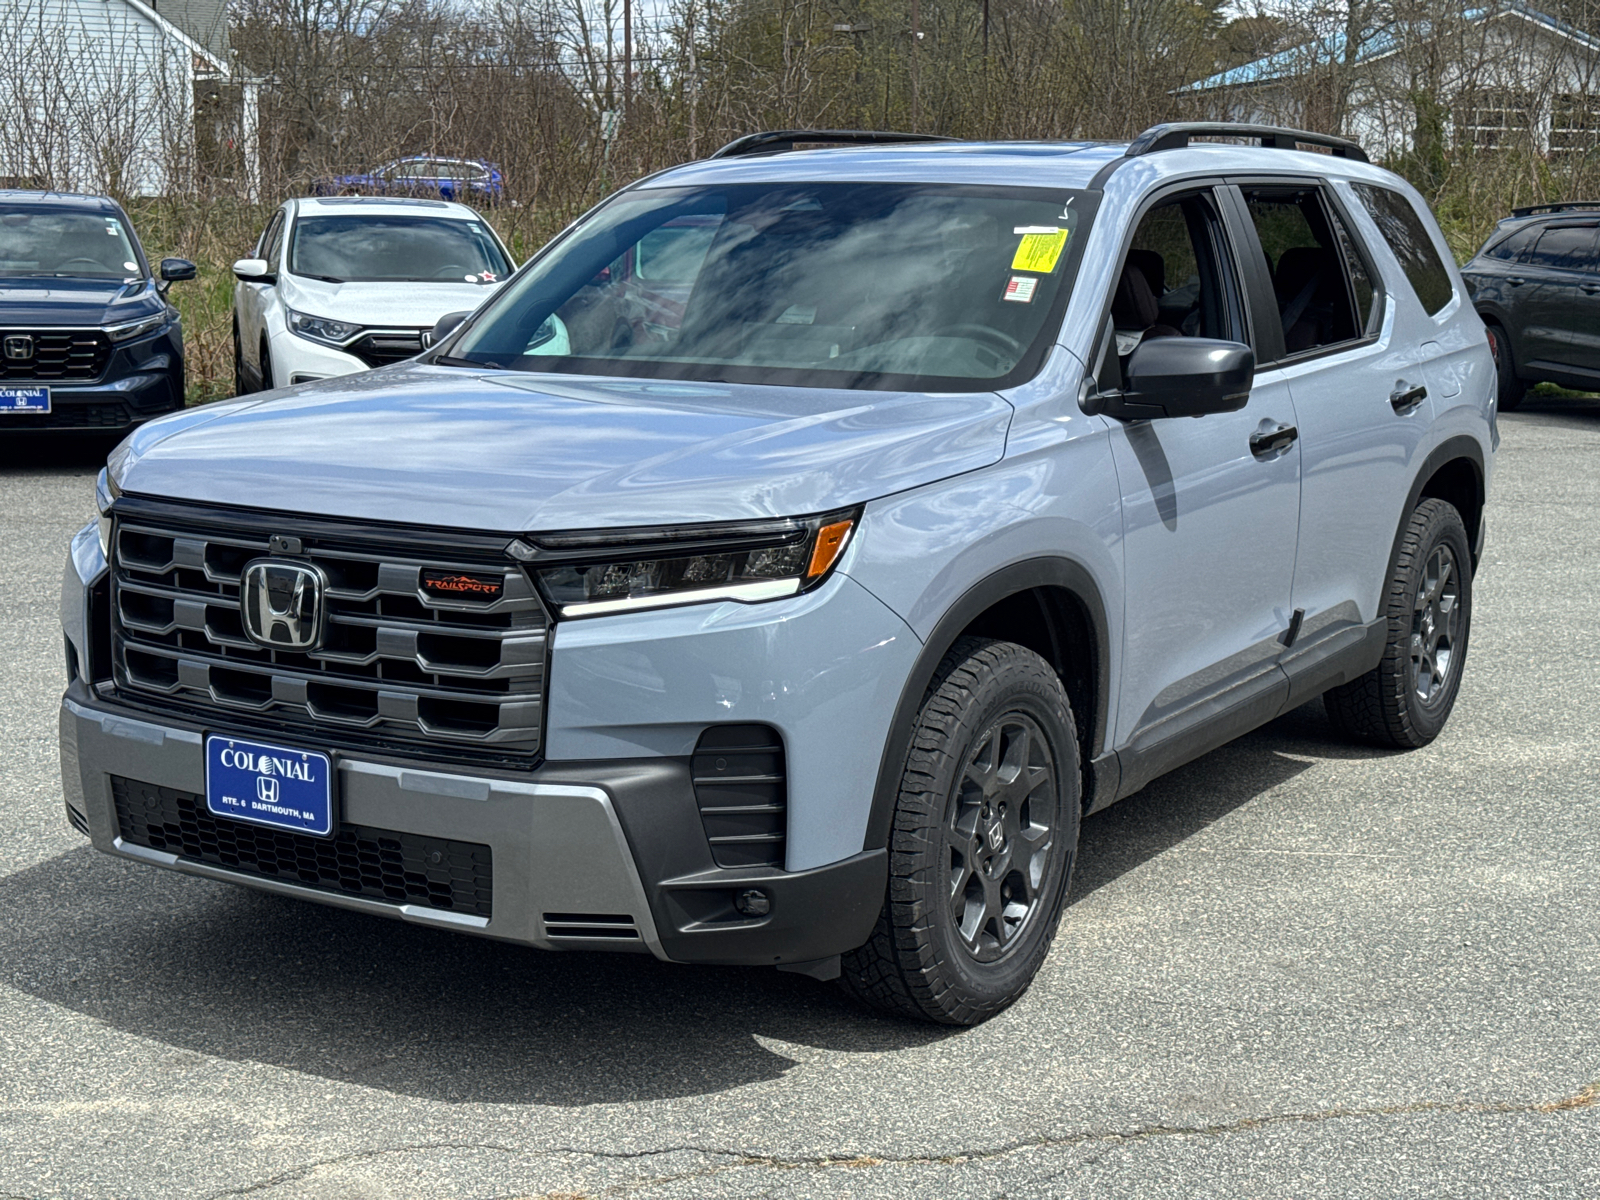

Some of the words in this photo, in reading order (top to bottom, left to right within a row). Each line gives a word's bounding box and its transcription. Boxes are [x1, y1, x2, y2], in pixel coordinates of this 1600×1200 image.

[426, 580, 499, 593] TRAILSPORT
[220, 748, 315, 782] COLONIAL
[222, 796, 239, 806] RTE.
[241, 799, 246, 807] 6
[252, 801, 301, 819] DARTMOUTH,
[303, 811, 315, 821] MA
